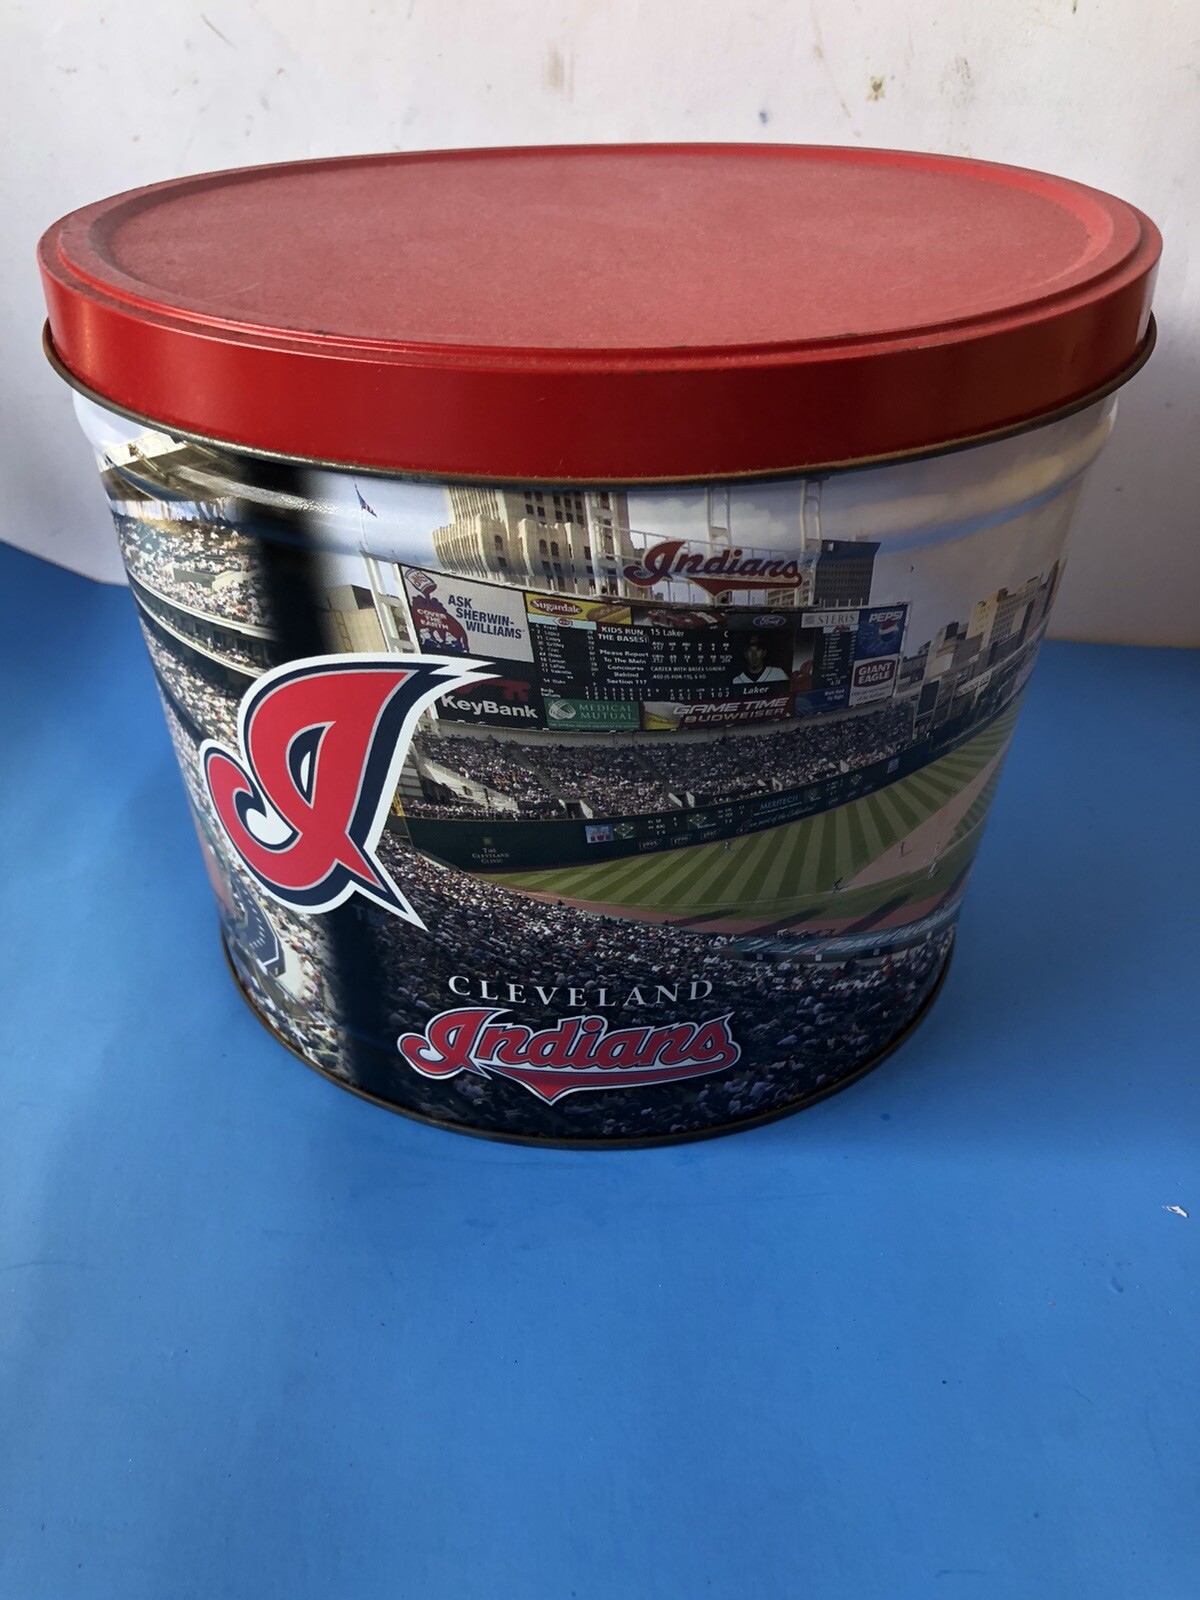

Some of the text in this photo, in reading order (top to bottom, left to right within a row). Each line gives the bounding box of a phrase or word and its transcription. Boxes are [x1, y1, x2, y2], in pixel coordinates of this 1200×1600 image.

[623, 539, 802, 596] Indians
[448, 595, 472, 609] ASK
[531, 599, 580, 614] Sugardale
[417, 608, 447, 620] COVER
[456, 608, 515, 627] SHERWIN-
[758, 614, 781, 626] Ford
[818, 611, 855, 624] STERIS
[868, 610, 904, 624] PEPSI
[420, 619, 449, 630] EARTH
[466, 621, 522, 639] WILLIAMS
[601, 626, 644, 636] KIDS RUN
[598, 633, 615, 641] THE
[650, 628, 661, 636] 15
[662, 629, 685, 638] Laker
[624, 650, 649, 658] Report
[858, 662, 893, 676] GIANT
[858, 670, 891, 684] EAGLE
[743, 685, 769, 695] Laker
[440, 694, 538, 719] KeyBank
[673, 697, 790, 715] GAME TIME
[580, 712, 632, 720] MUTUAL
[684, 707, 785, 724] BUDWEISER
[759, 794, 799, 810] MERITECH
[448, 975, 713, 1007] CLEVELAND
[397, 1006, 742, 1104] Indians
